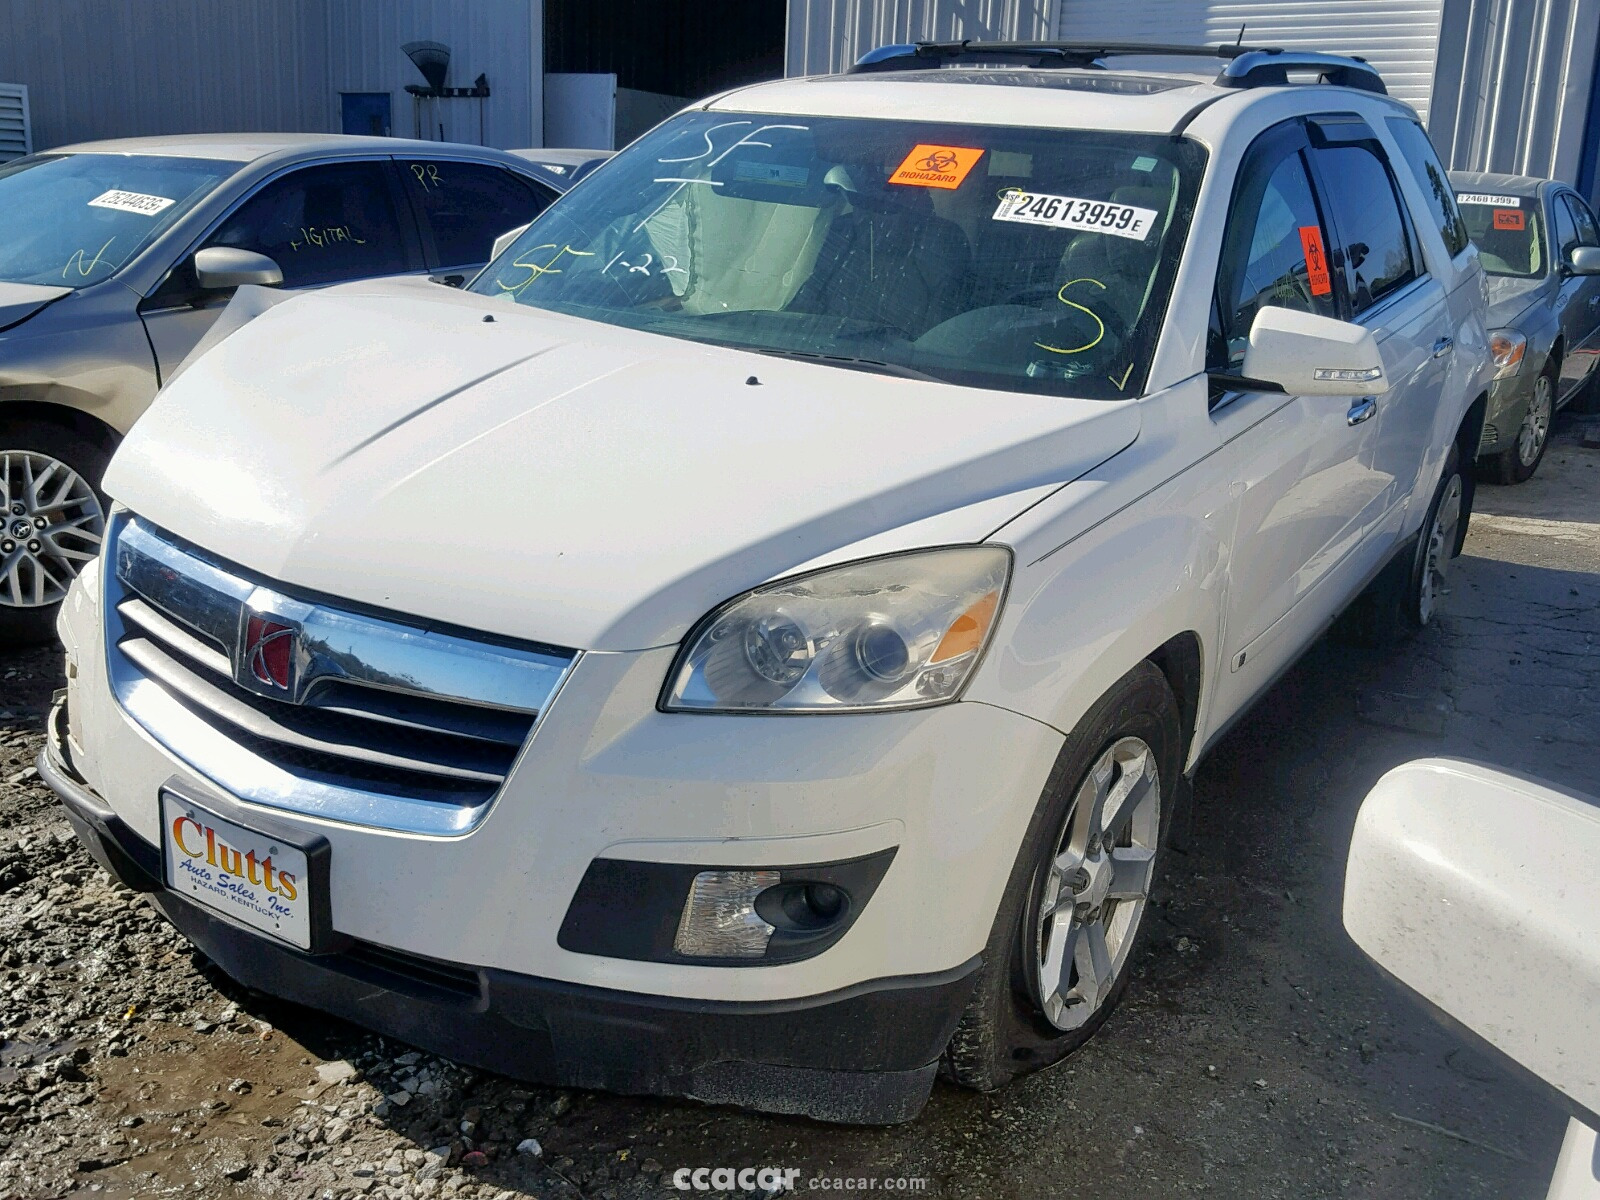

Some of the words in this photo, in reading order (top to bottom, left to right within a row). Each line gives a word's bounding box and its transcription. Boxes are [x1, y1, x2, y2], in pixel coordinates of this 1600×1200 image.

[658, 121, 809, 167] SF
[411, 164, 446, 193] PR
[899, 171, 957, 183] BIOHAZARD
[601, 250, 688, 276] 1-22
[1033, 278, 1107, 354] S
[172, 816, 298, 902] Clutts
[179, 858, 213, 881] Auto
[267, 896, 295, 919] Inc.
[190, 876, 230, 900] HAZARD,
[231, 895, 282, 921] KENTUCKY
